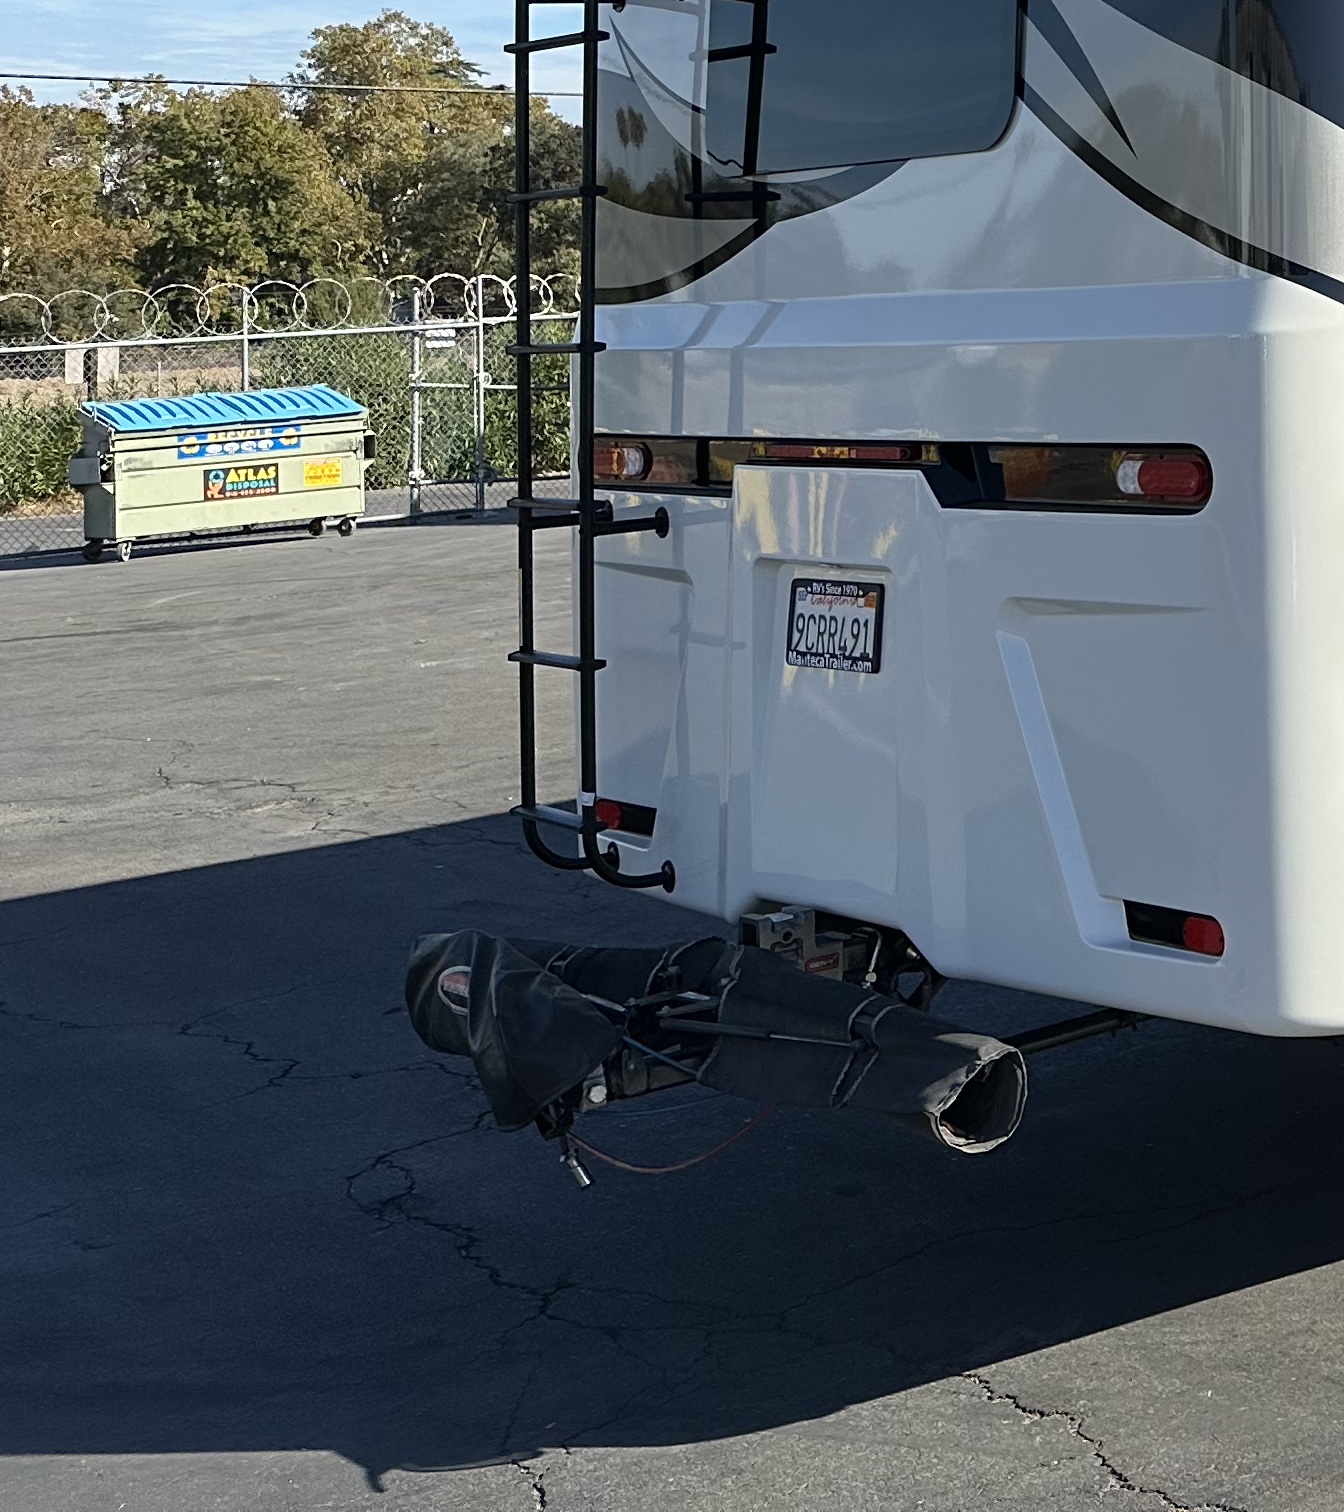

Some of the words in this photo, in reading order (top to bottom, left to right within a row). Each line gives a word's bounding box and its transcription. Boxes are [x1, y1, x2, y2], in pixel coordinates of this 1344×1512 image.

[225, 466, 277, 483] ATLAS
[225, 479, 276, 491] DISPOSAL
[812, 582, 825, 594] RV's
[825, 583, 842, 595] Since
[842, 584, 858, 596] 1970
[794, 613, 869, 657] 9CRR491
